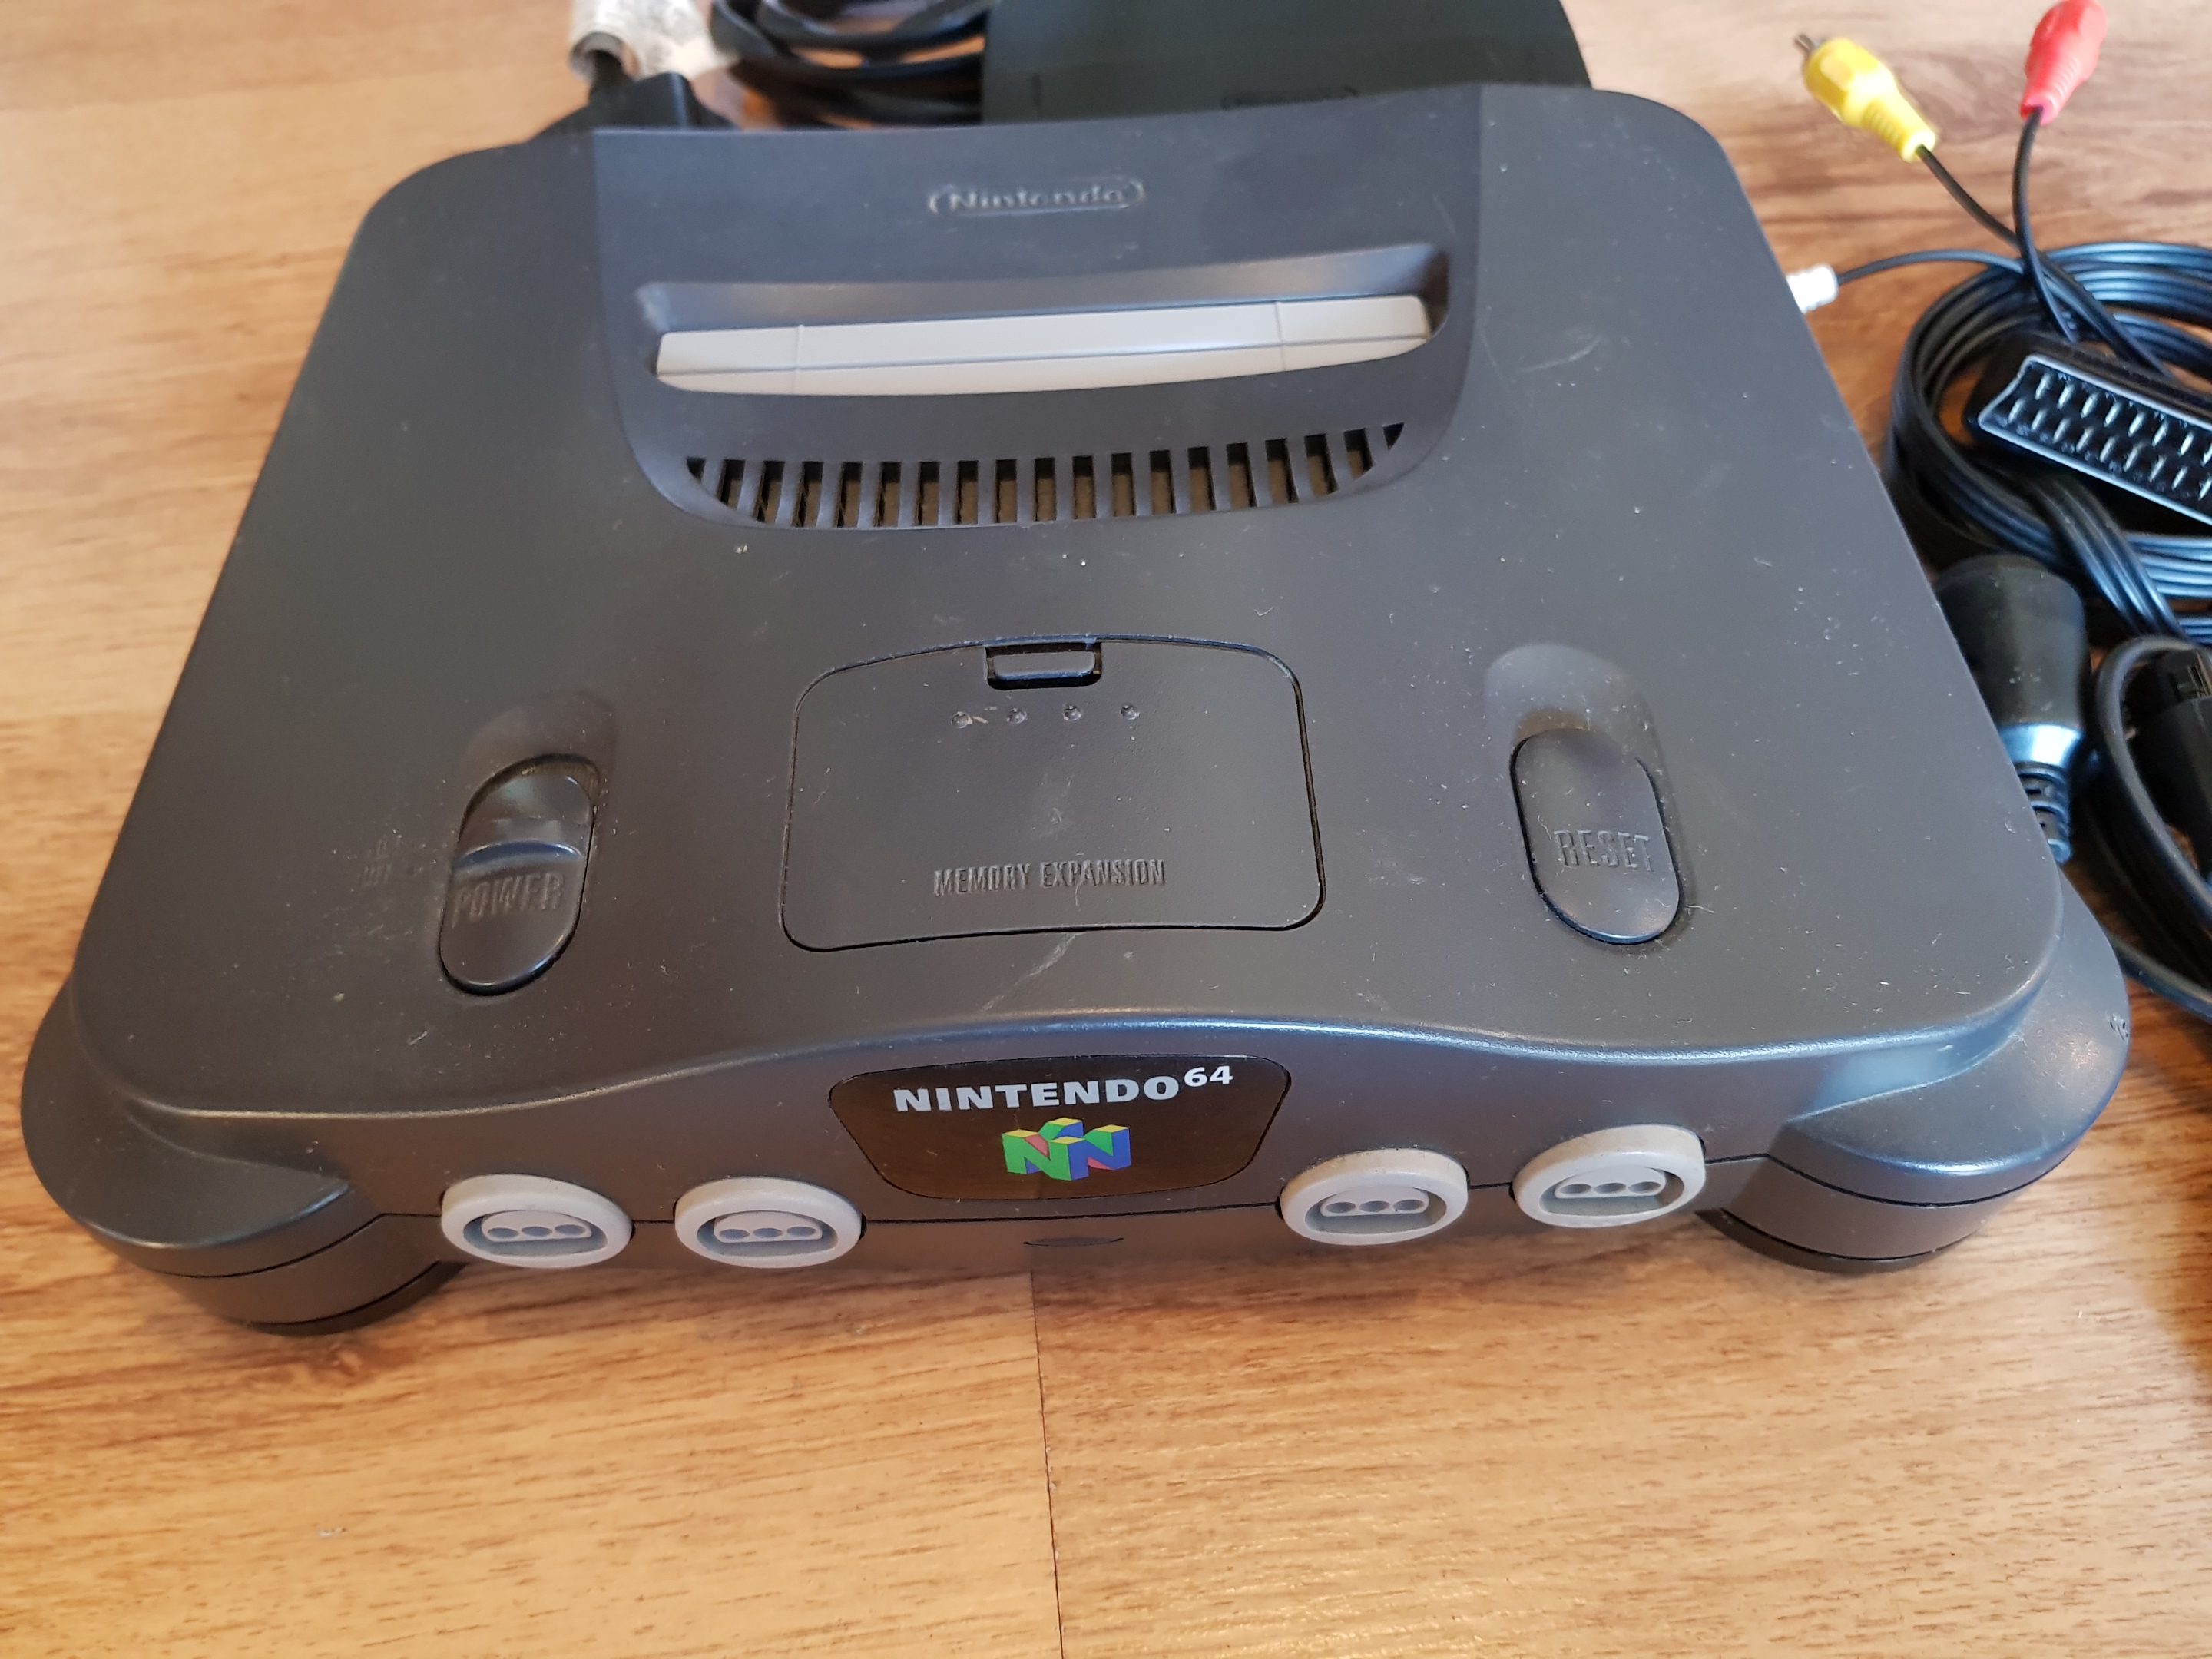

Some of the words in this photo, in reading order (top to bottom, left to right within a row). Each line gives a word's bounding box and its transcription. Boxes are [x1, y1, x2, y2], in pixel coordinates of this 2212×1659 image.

[948, 185, 1124, 210] Nintendo
[1553, 830, 1653, 872] RESET
[933, 863, 1031, 897] MEMORY
[1040, 859, 1167, 889] EXPANSION
[451, 871, 564, 929] POWER
